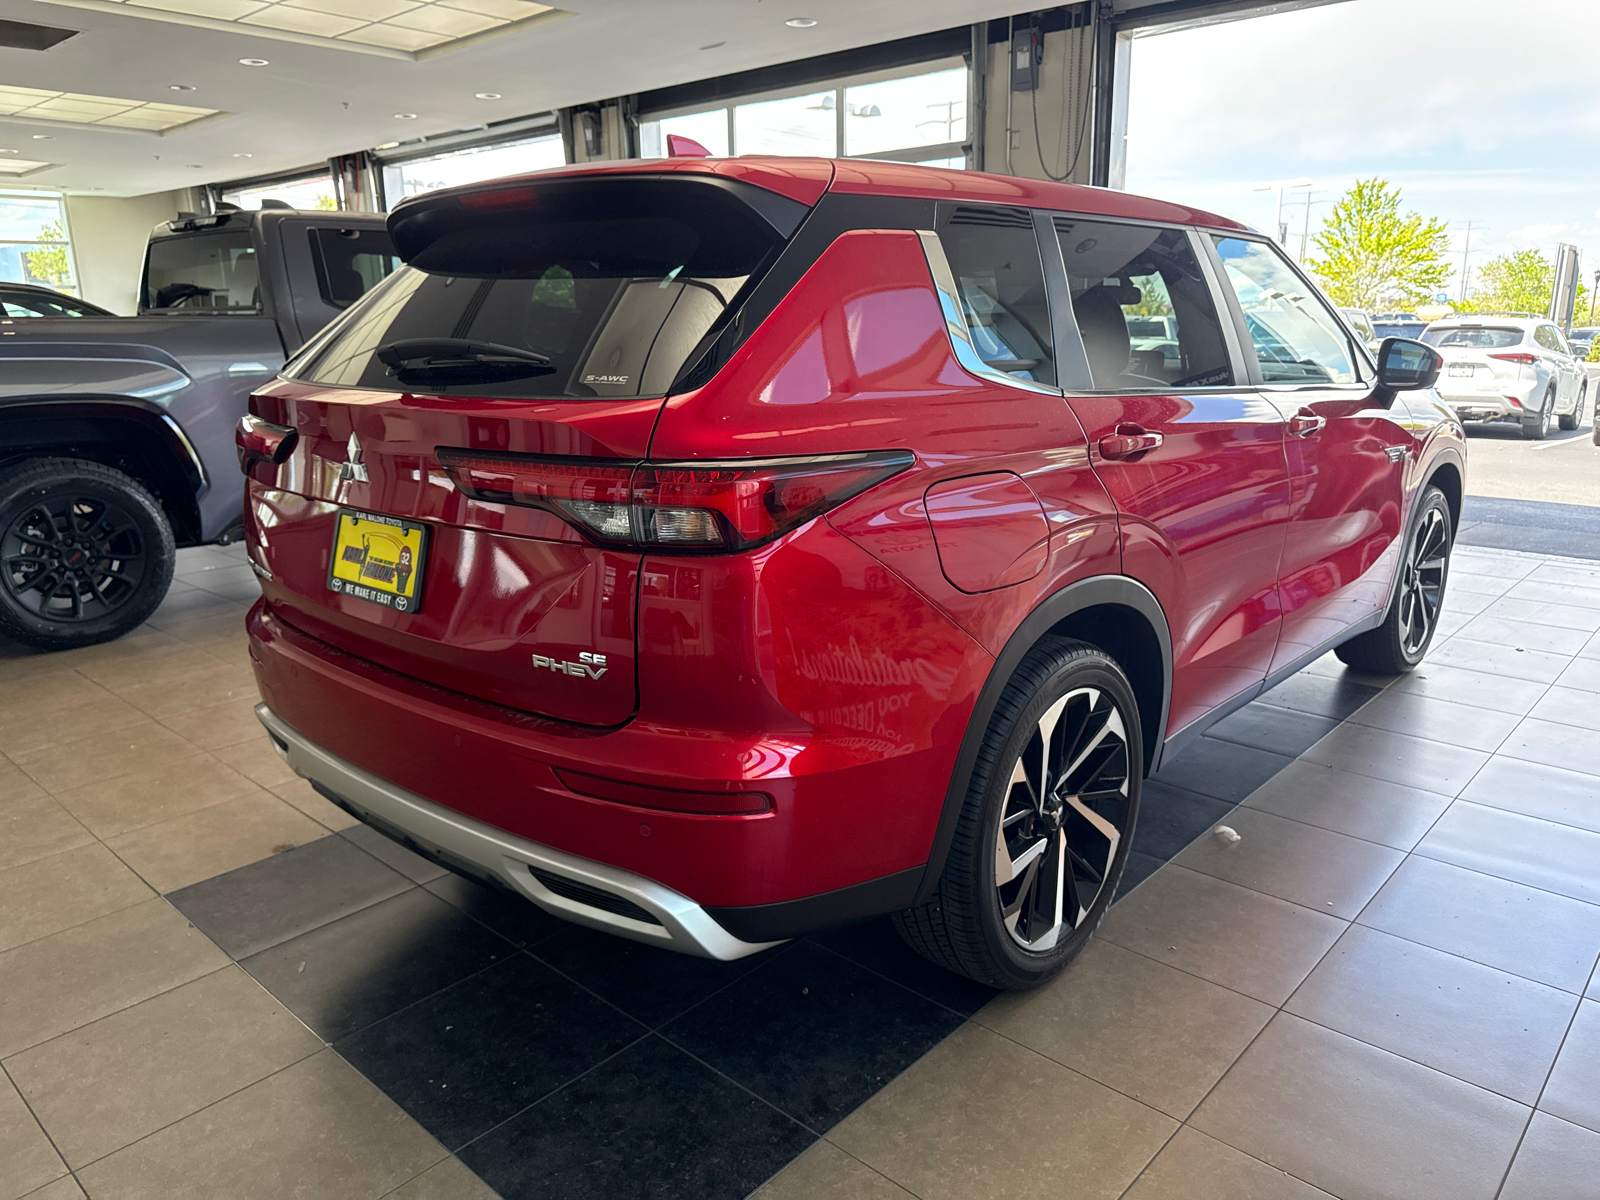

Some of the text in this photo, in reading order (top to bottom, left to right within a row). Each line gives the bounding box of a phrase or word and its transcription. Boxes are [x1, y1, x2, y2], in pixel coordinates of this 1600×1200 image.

[585, 374, 629, 382] S-AWC
[356, 512, 402, 527] KARL MALONE TOYOTA
[342, 545, 364, 564] KARL
[401, 552, 410, 565] 32
[363, 561, 396, 584] MALONE
[345, 583, 392, 605] WE MAKE IT EASY
[532, 653, 609, 680] PHEV
[579, 651, 607, 666] SE
